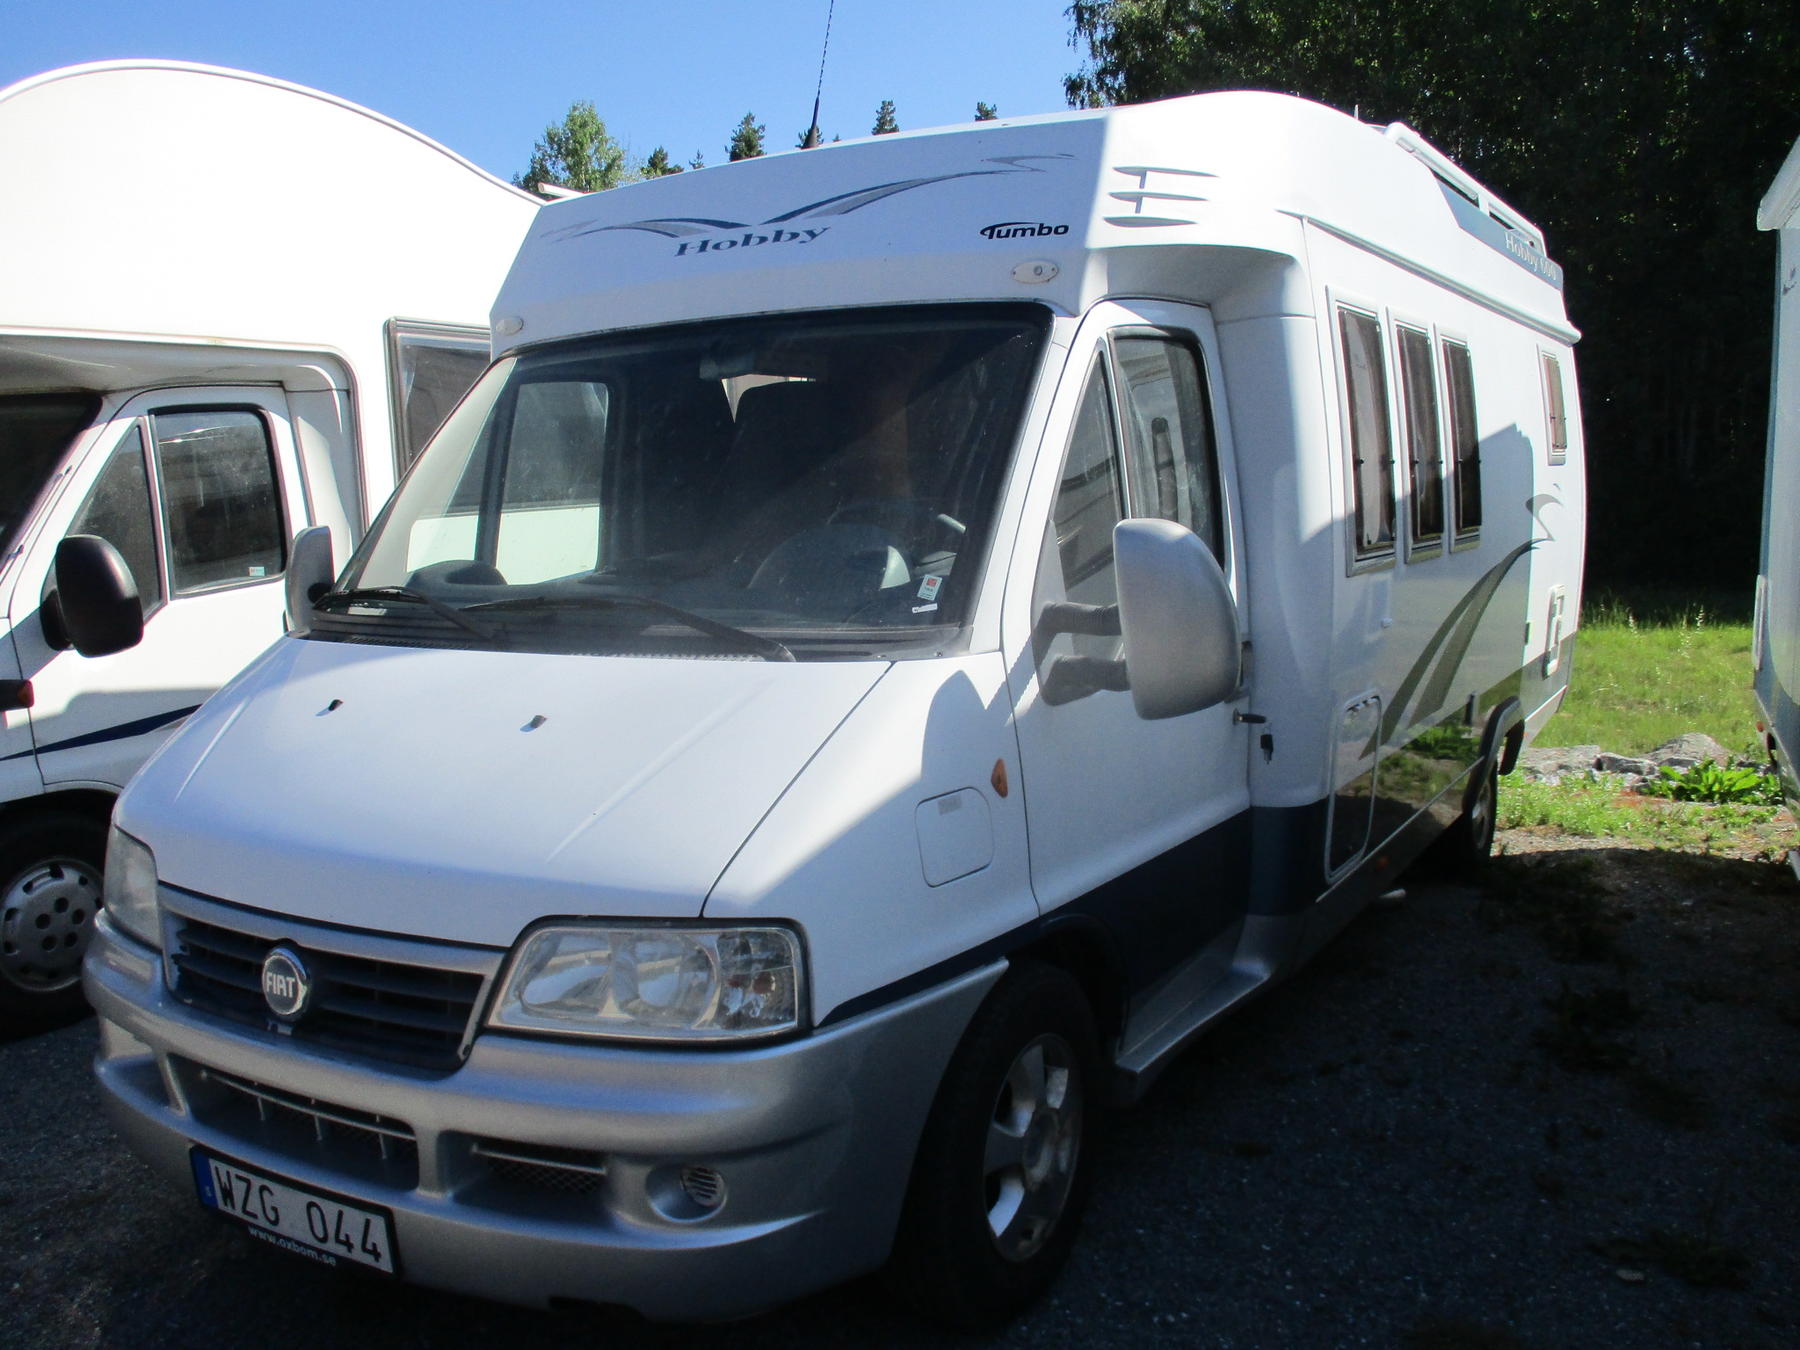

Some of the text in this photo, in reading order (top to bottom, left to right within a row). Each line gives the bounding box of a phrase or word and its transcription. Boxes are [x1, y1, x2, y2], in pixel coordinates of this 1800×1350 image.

[674, 226, 831, 257] Hobby
[1503, 231, 1538, 273] Hobby
[266, 971, 296, 998] FIAT
[214, 1165, 382, 1264] WZG 044
